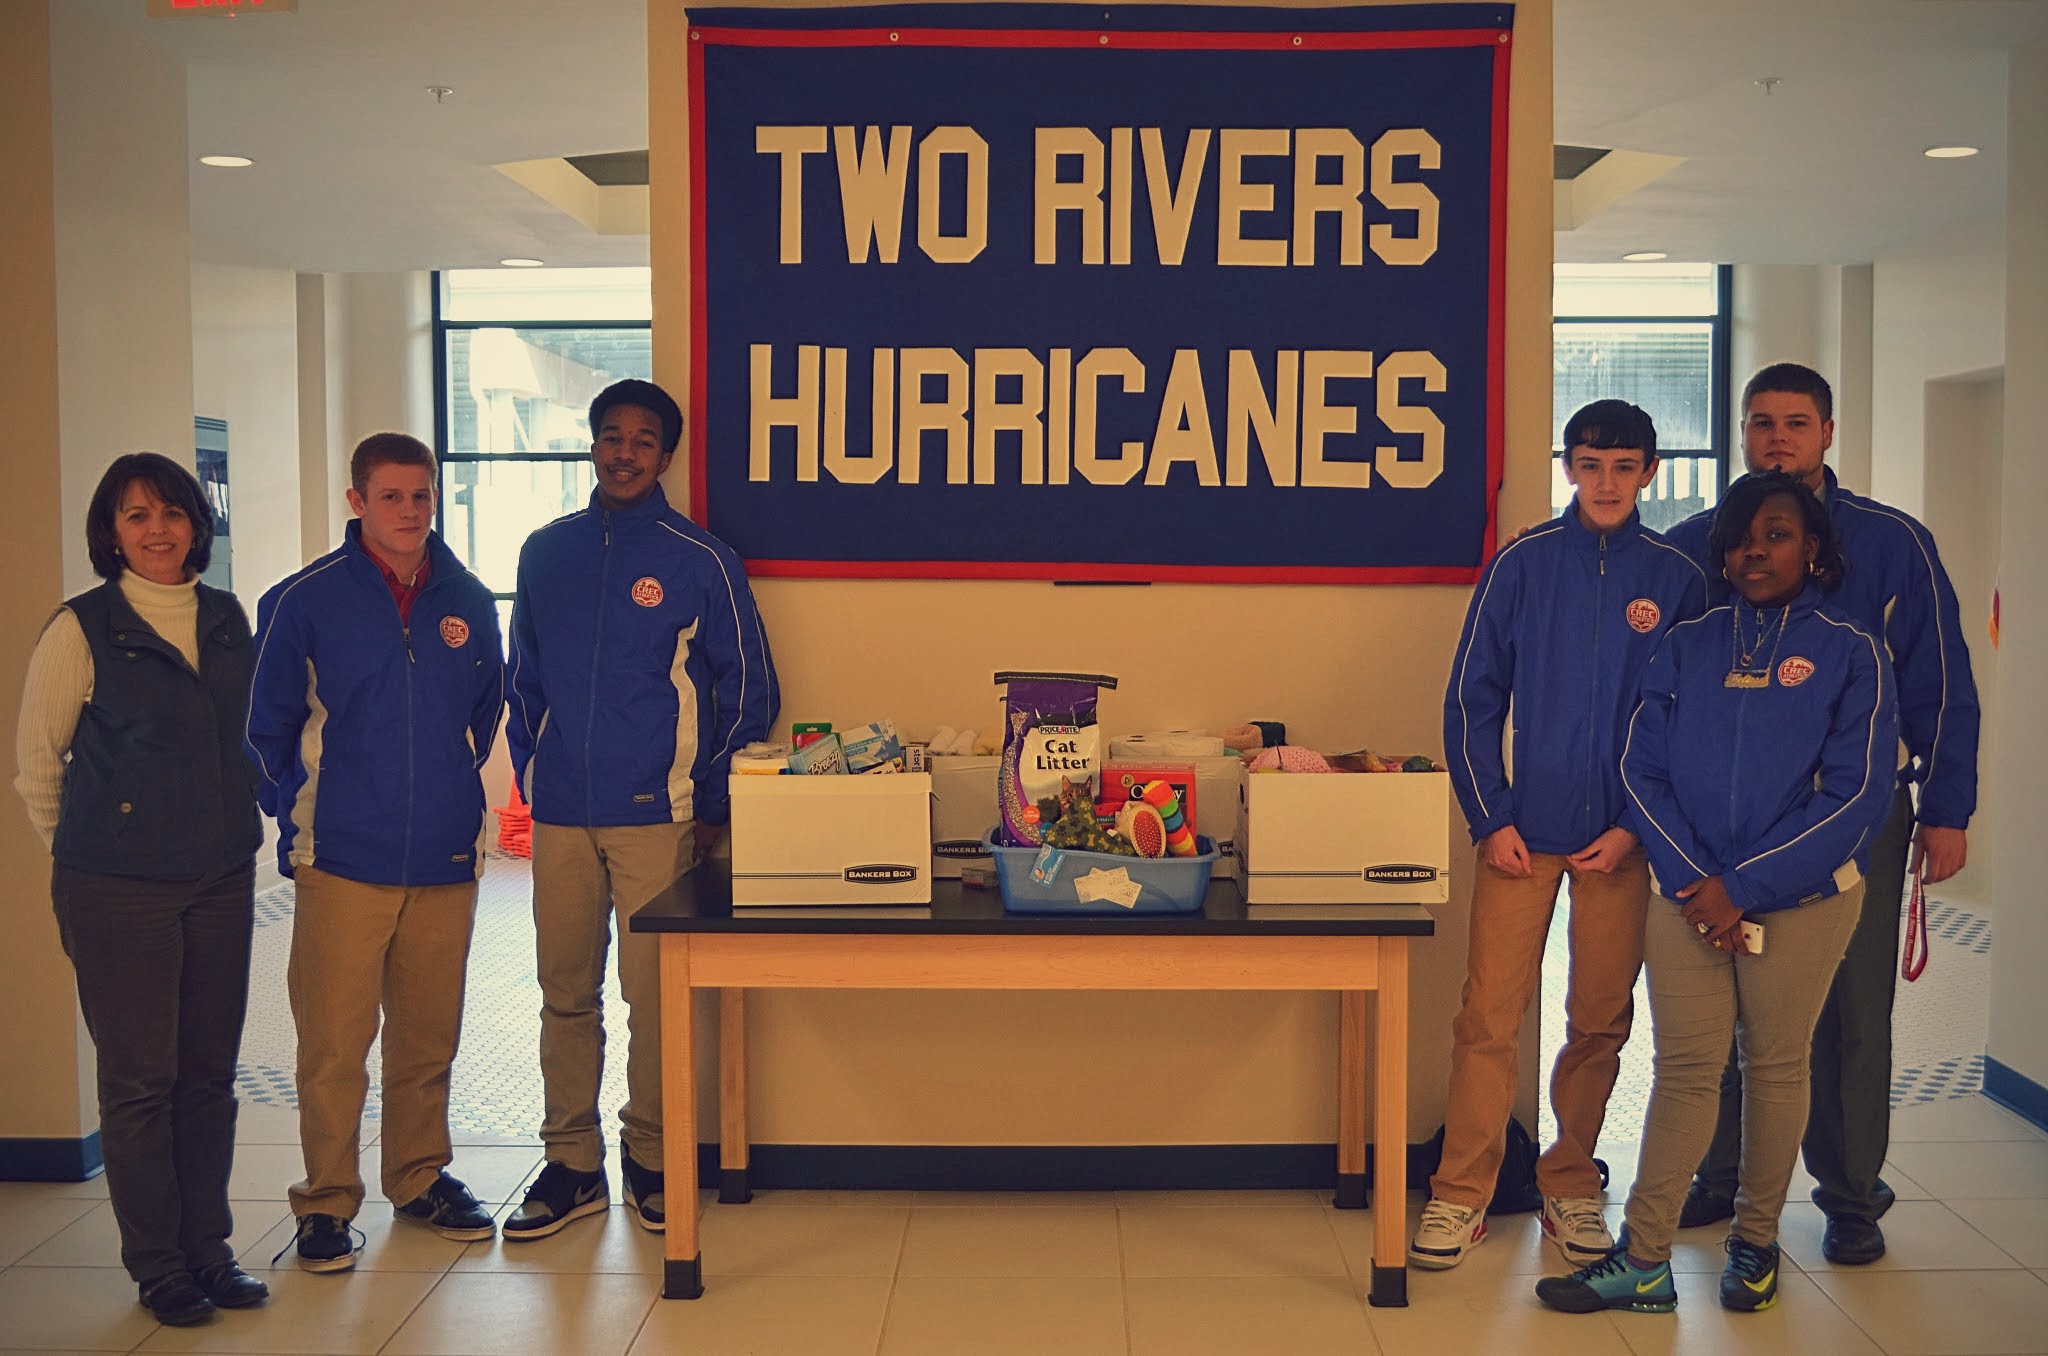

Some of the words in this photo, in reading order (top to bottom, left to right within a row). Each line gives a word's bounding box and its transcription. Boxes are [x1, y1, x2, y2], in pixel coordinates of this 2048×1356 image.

[756, 125, 989, 264] TWO
[1034, 127, 1441, 266] RIVERS
[749, 344, 1447, 489] HURRICANES
[637, 585, 659, 596] CREC
[1630, 608, 1655, 618] CREC
[1783, 666, 1809, 674] CREC
[1045, 739, 1077, 753] Cat
[1036, 755, 1090, 770] Litter
